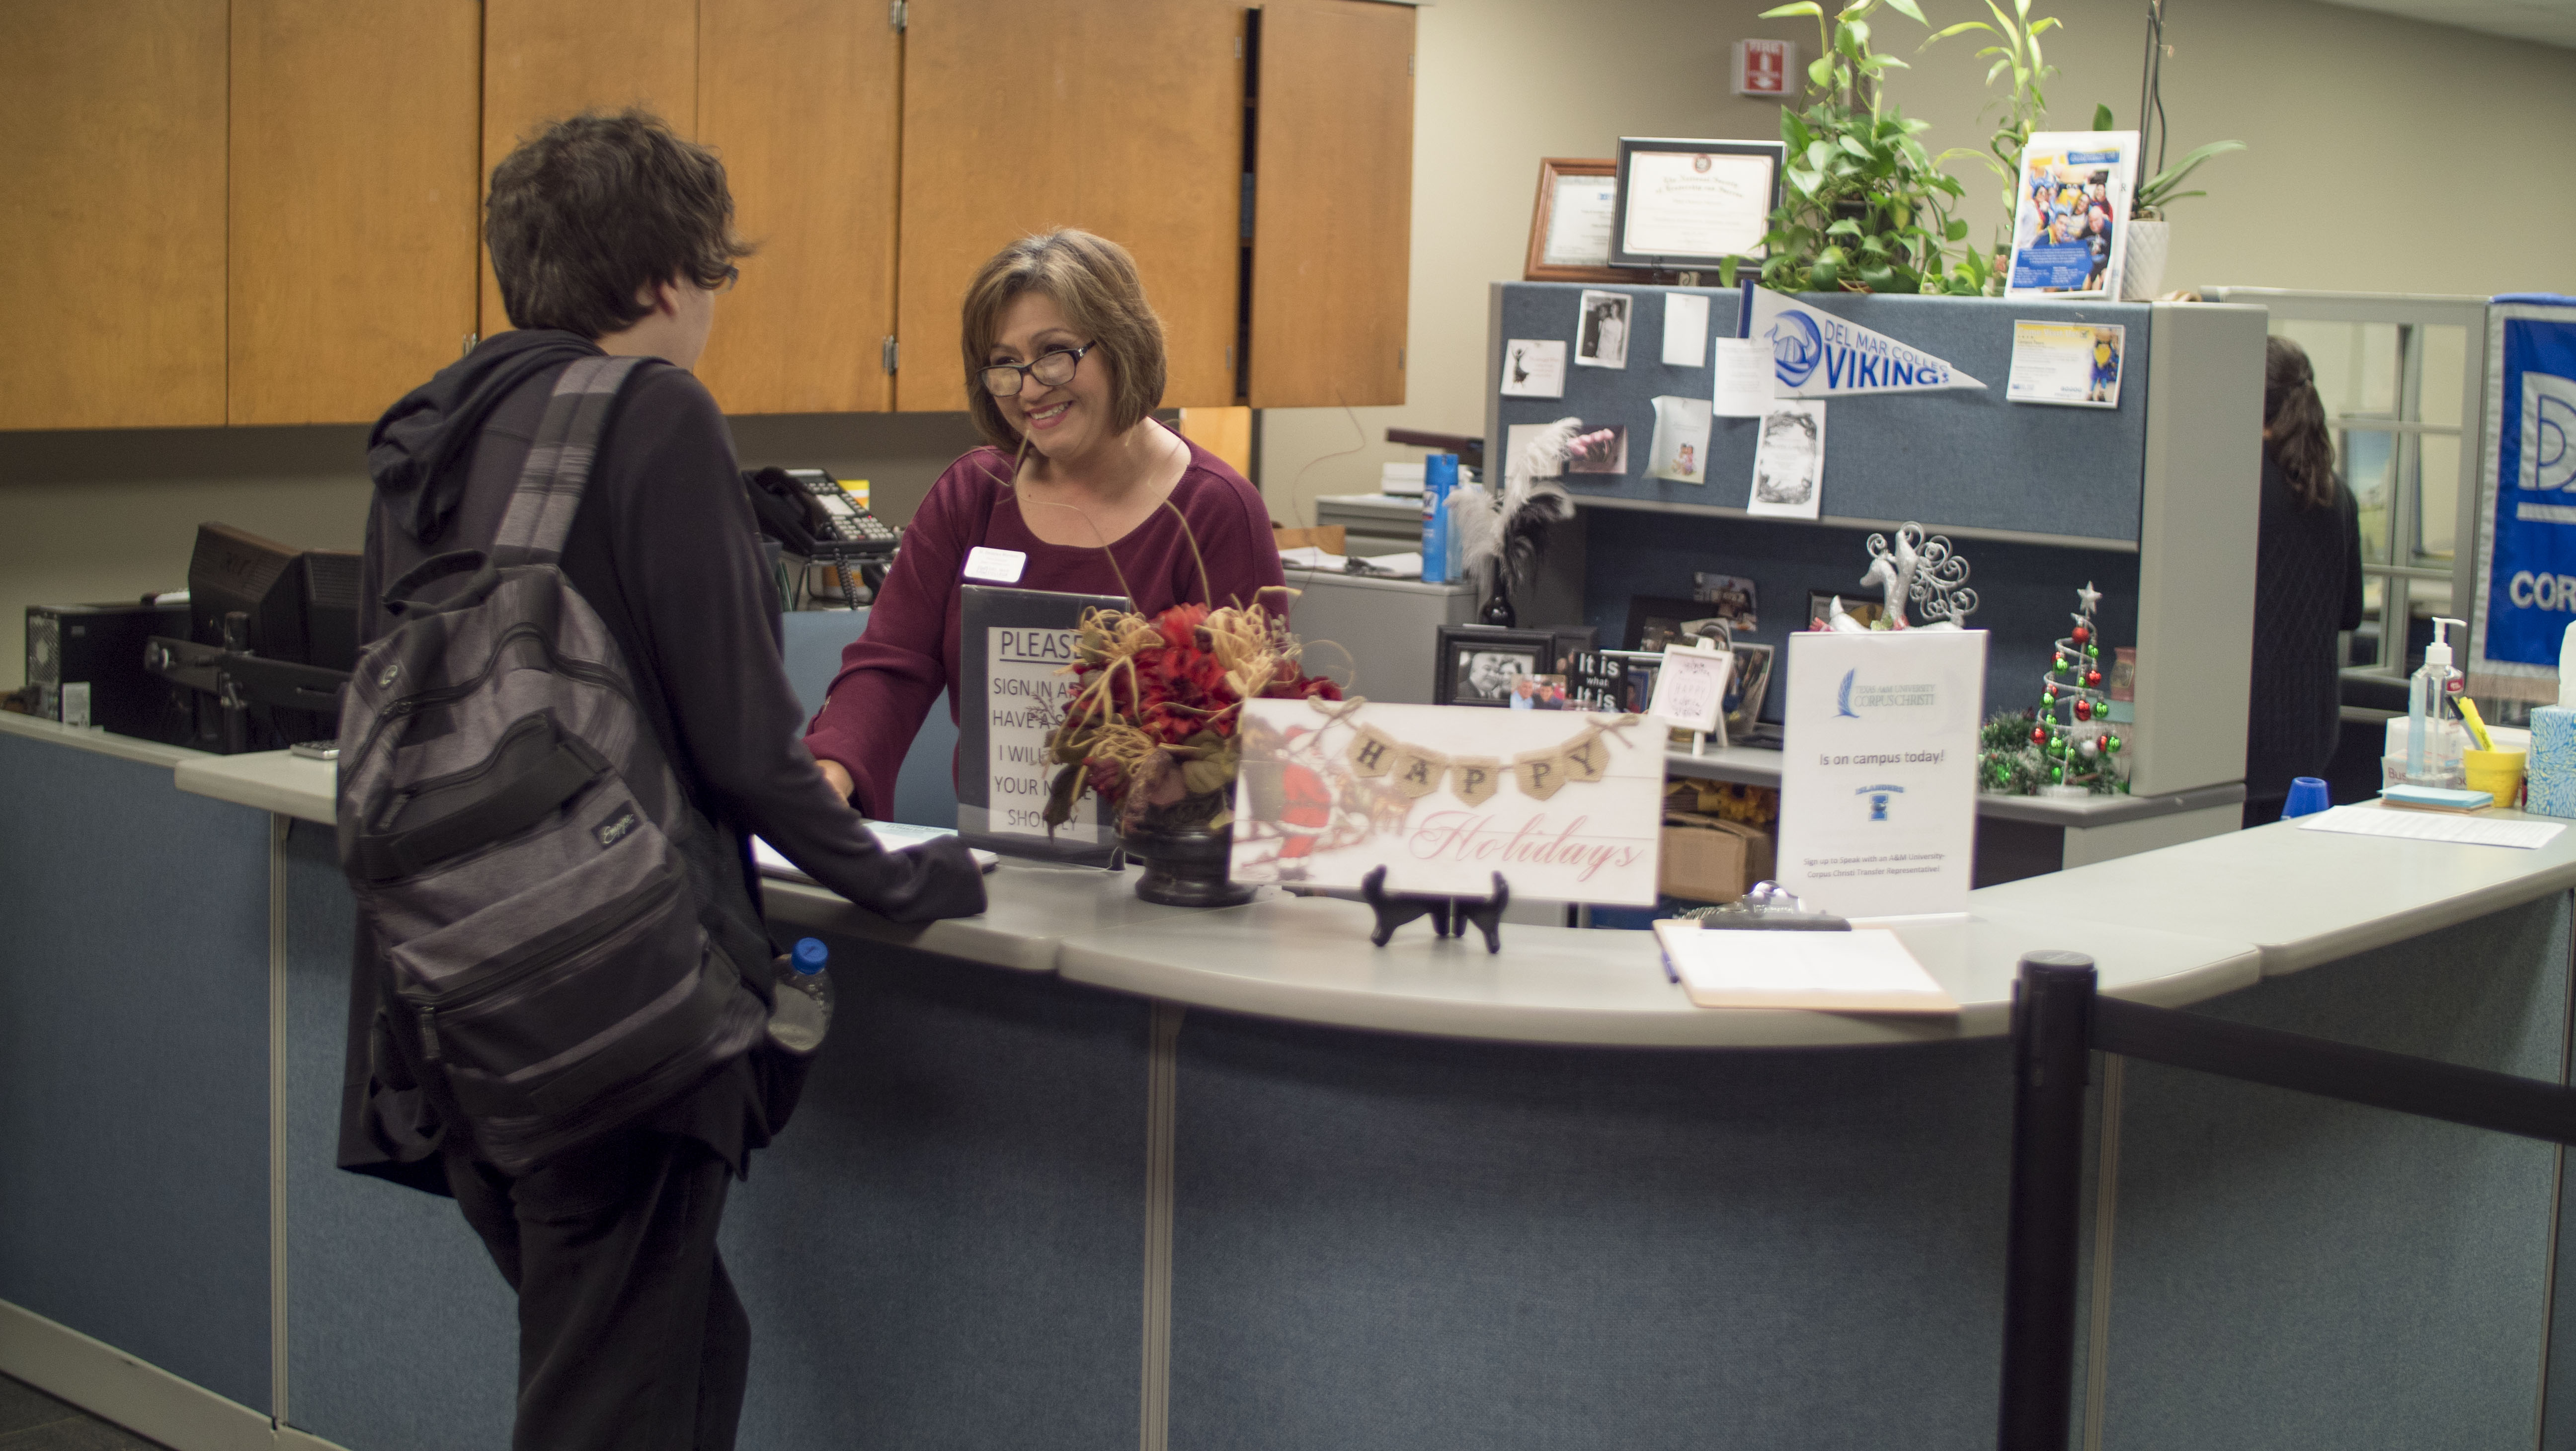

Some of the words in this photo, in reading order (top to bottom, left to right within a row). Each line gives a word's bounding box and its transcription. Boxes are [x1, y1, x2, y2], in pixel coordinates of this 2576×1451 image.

[1824, 319, 1852, 347] DEL
[1856, 331, 1888, 356] MAR
[1579, 652, 1595, 674] It
[1601, 655, 1620, 677] is
[994, 677, 1030, 696] SIGN
[1036, 680, 1052, 697] IN
[1586, 676, 1609, 687] what
[1855, 685, 1875, 694] TEXAS
[1895, 683, 1936, 693] UNIVERSITY
[1596, 687, 1615, 709] is
[1854, 694, 1894, 707] CORPUS
[1895, 693, 1934, 706] CHRISTI
[993, 710, 1035, 728] HAVE
[1039, 713, 1050, 729] A
[999, 744, 1003, 761] I
[1819, 753, 1829, 766] Is
[1833, 755, 1849, 765] on
[1853, 752, 1901, 766] campus
[1905, 749, 1944, 764] today!
[1357, 739, 1596, 794] HAPPY
[994, 776, 1038, 795] YOUR
[1855, 784, 1905, 795] ISLANDERS
[1409, 810, 1643, 883] Holidays
[1803, 858, 1818, 867] Sign
[1840, 856, 1860, 865] Speak
[1862, 855, 1877, 863] with
[1909, 852, 1946, 861] University-
[1807, 870, 1832, 879] Corpus
[1833, 869, 1855, 877] Christi
[1857, 867, 1885, 876] Transfer
[1887, 865, 1940, 876] Representative!
